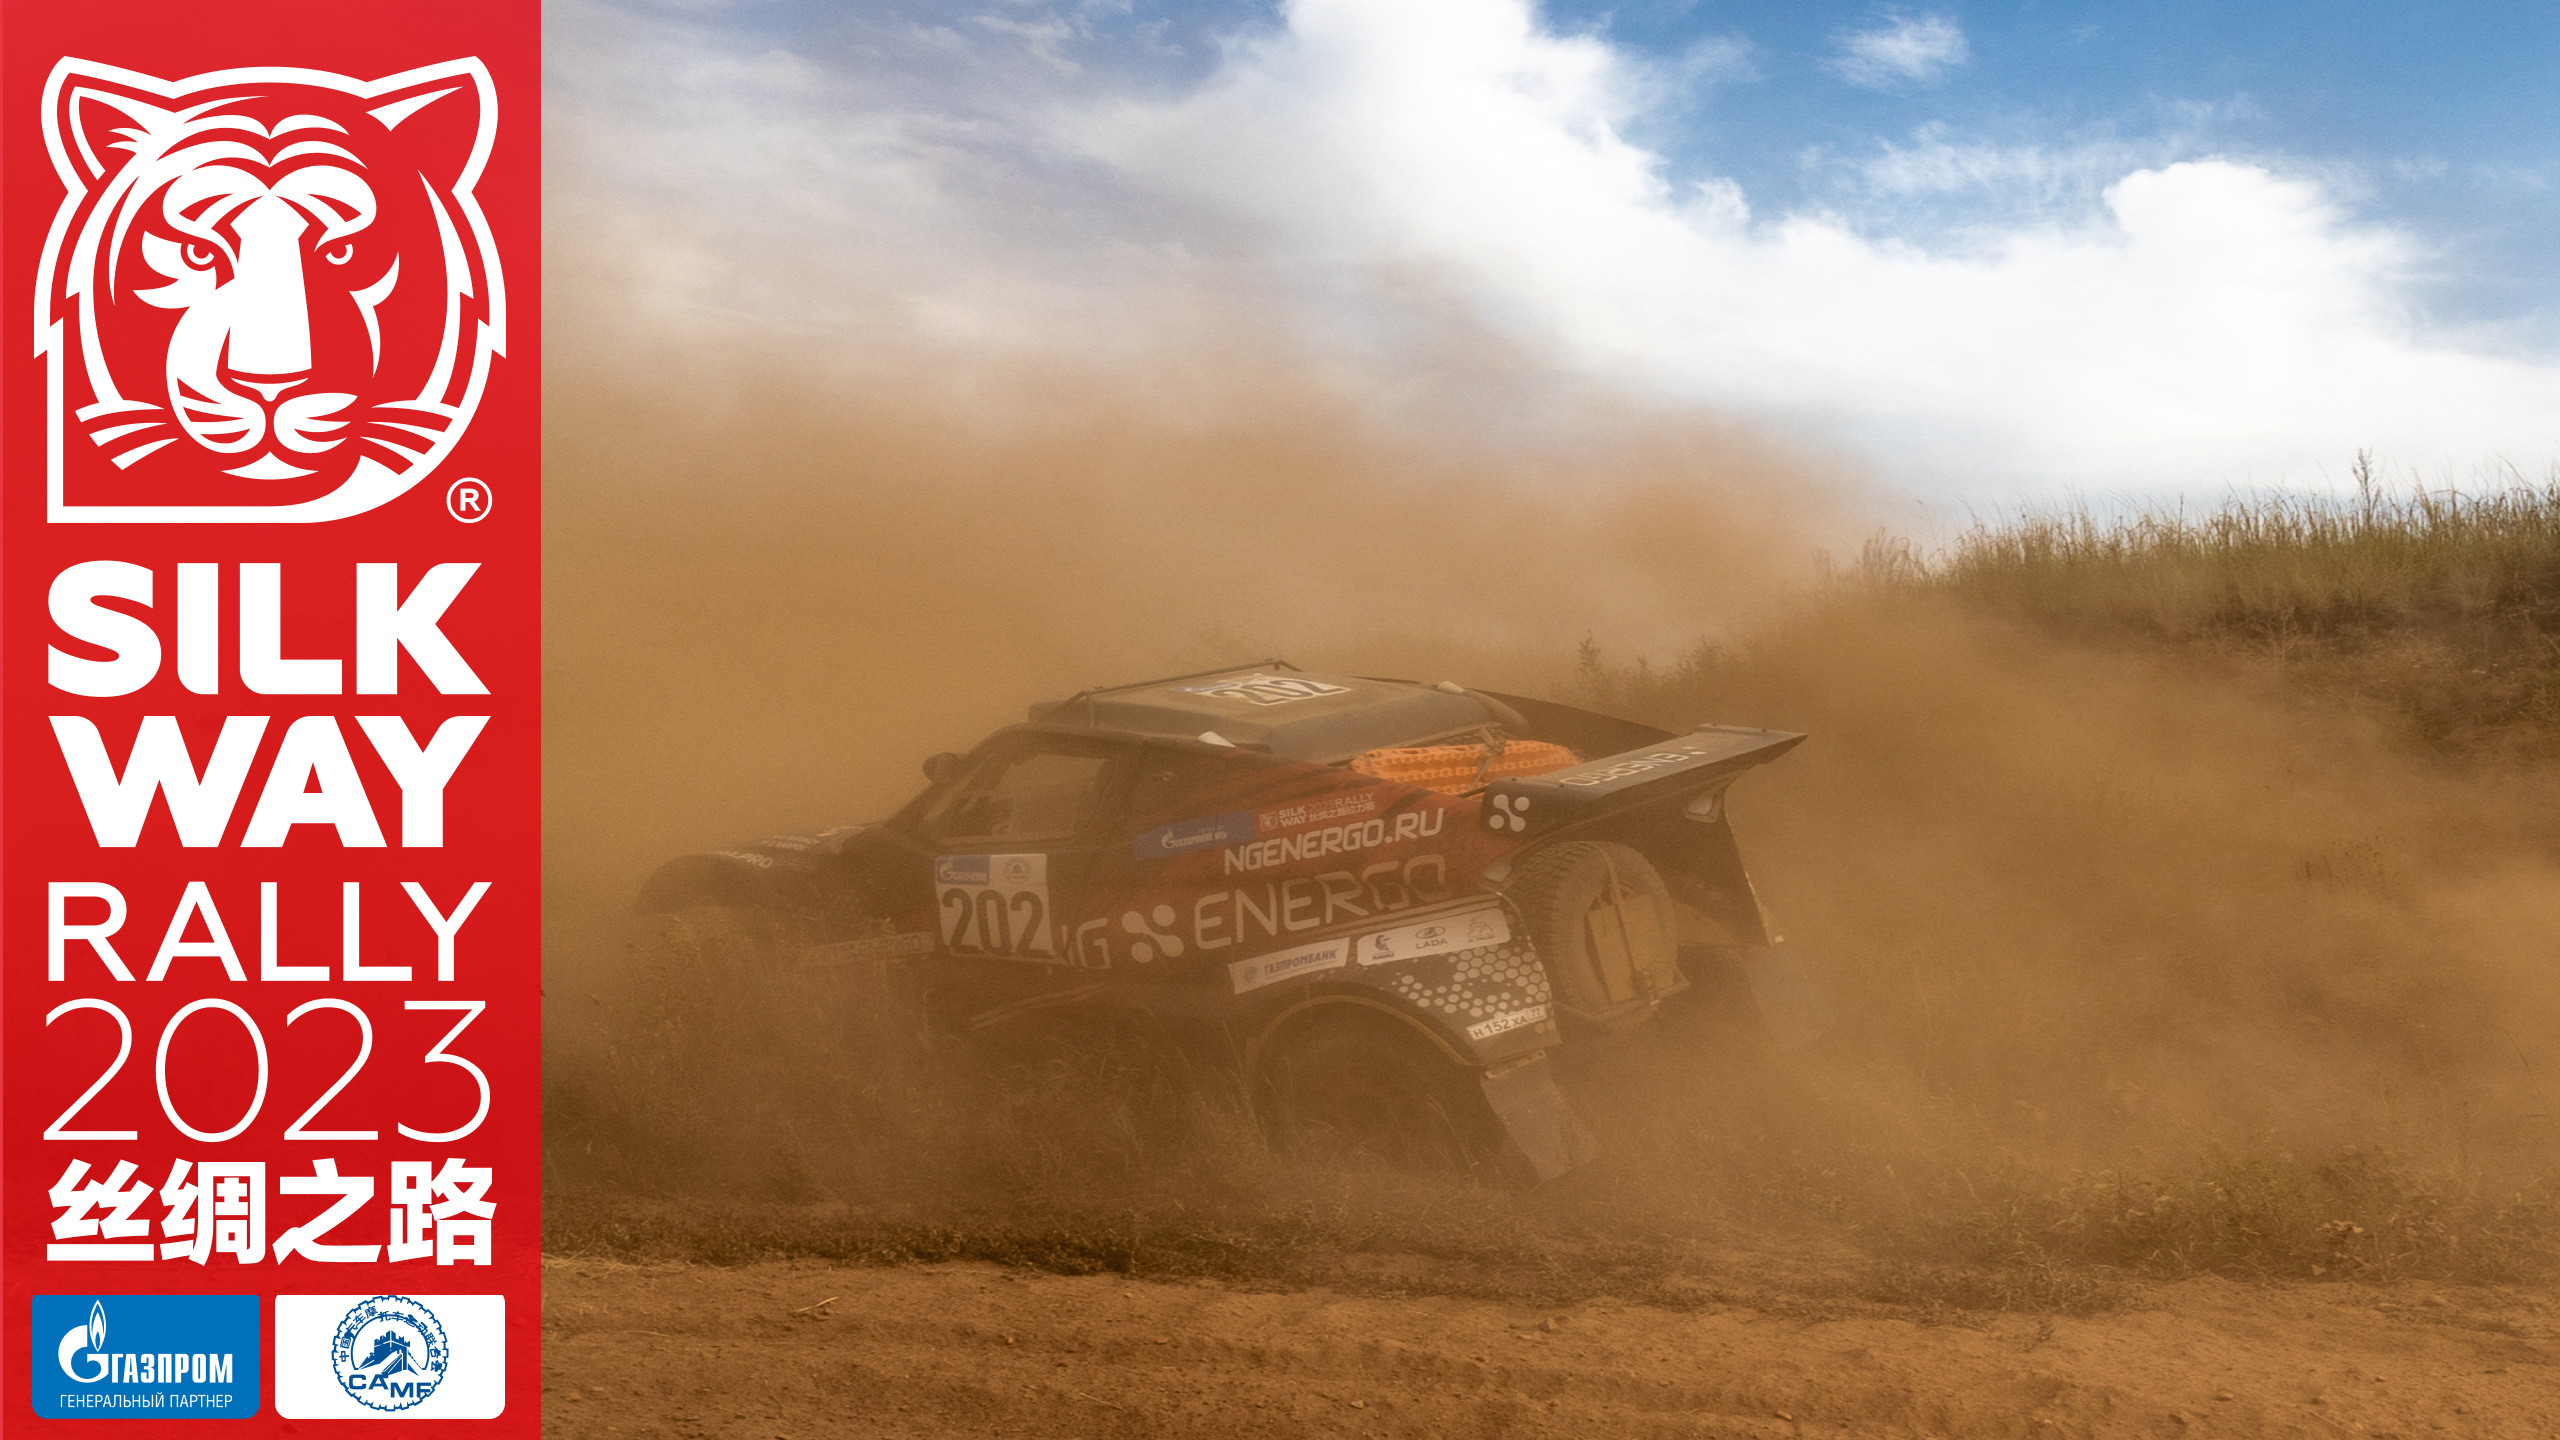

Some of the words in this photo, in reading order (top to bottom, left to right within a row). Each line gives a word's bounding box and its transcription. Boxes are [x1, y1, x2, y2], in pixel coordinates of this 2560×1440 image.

[1211, 679, 1346, 705] 202
[1278, 805, 1307, 820] SILK
[1334, 792, 1375, 813] RALLY
[1279, 814, 1307, 827] WAY
[1224, 808, 1444, 875] NGENERGO.RU
[1193, 854, 1453, 950] ENERGO
[942, 888, 1053, 960] 202
[1415, 938, 1449, 950] LADA
[1264, 948, 1338, 976] ГАЗПРОМБАНК
